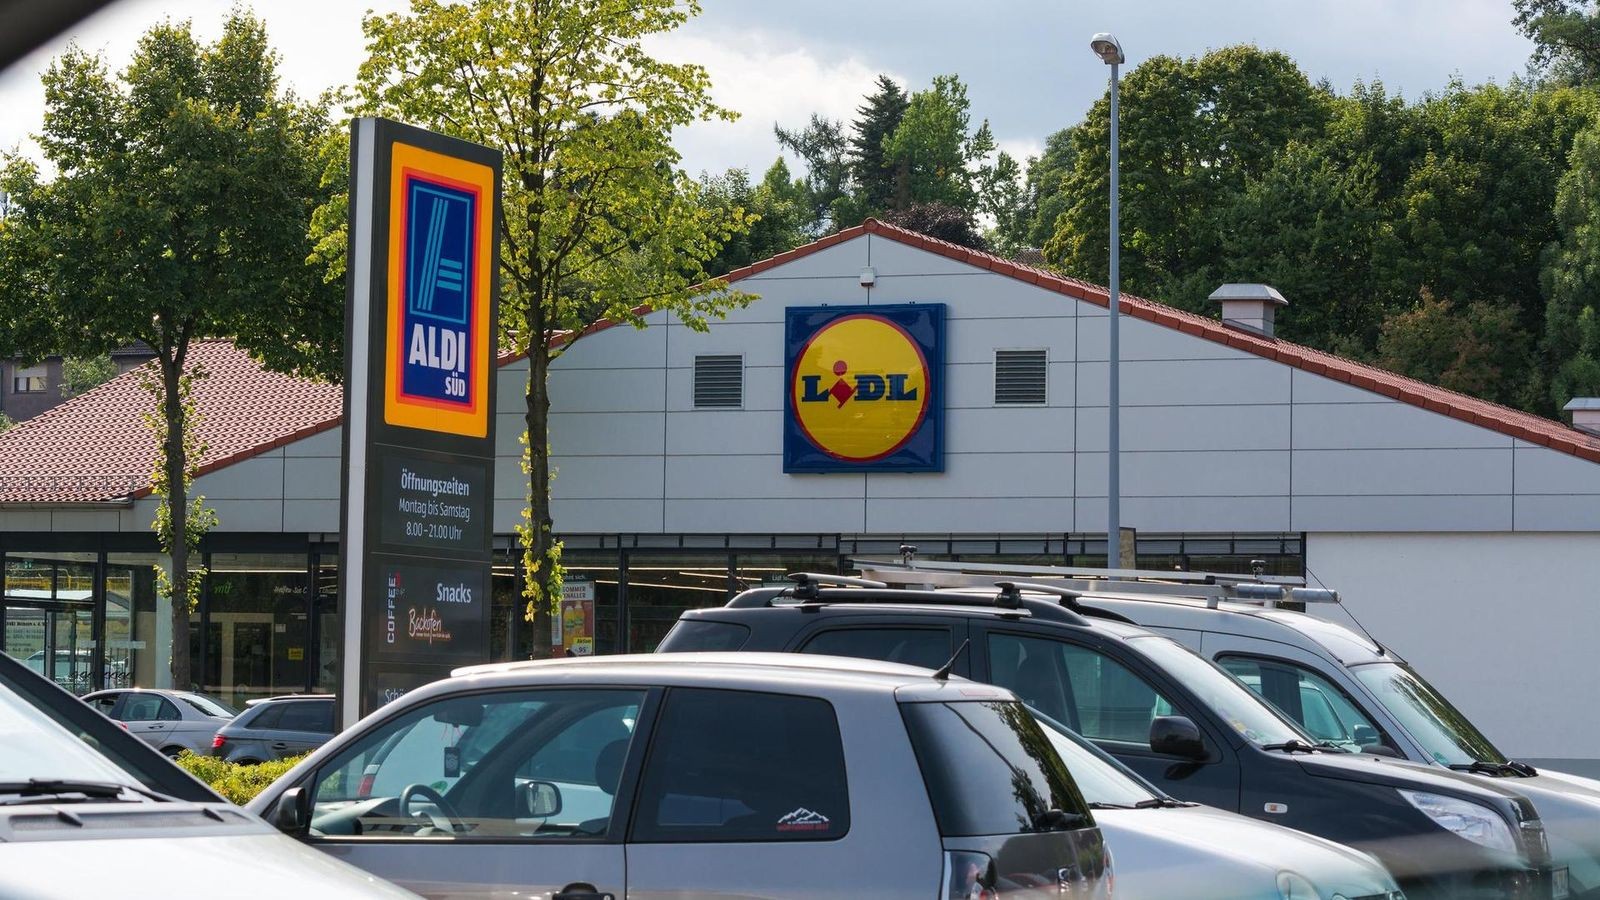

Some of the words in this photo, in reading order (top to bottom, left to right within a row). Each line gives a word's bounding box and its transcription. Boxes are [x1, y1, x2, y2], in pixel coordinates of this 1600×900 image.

[408, 323, 466, 373] ALDI
[445, 371, 466, 397] SÜD
[401, 467, 470, 497] Öffnungszeiten
[399, 498, 427, 519] Montag
[428, 500, 439, 516] bis
[439, 502, 471, 523] Samstag
[448, 524, 463, 541] Uhr
[436, 582, 472, 604] Snacks
[387, 577, 396, 644] COFFEE
[408, 608, 442, 645] Backofen
